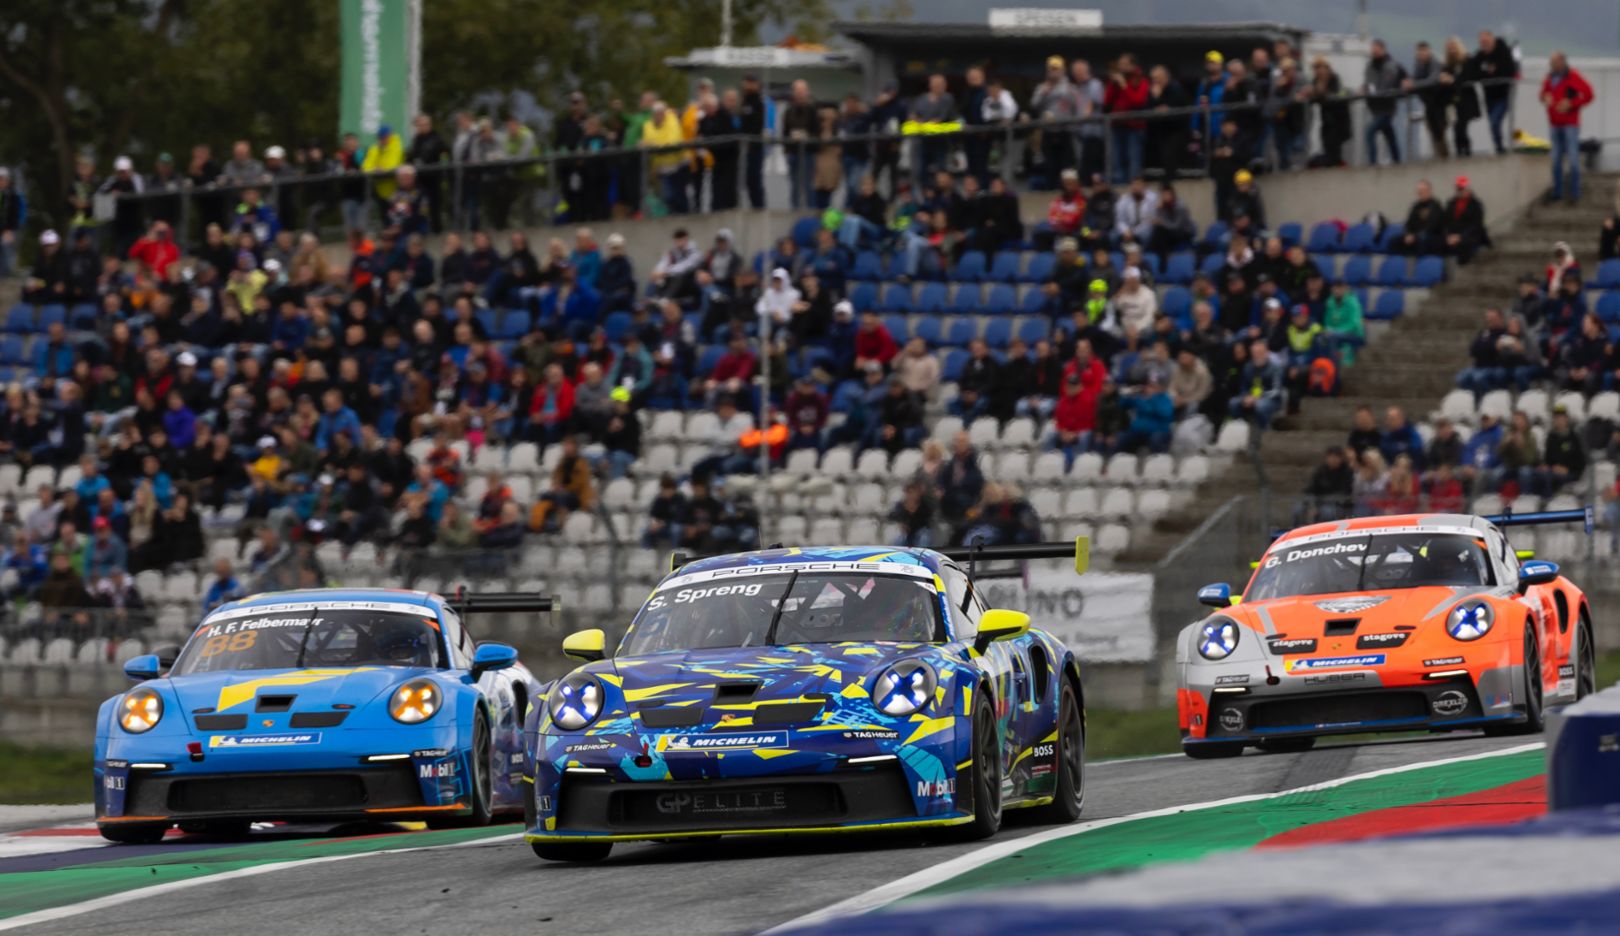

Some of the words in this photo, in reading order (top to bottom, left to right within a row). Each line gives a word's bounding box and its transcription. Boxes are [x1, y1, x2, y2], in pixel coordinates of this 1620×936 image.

[1265, 556, 1282, 569] G.
[1286, 543, 1368, 562] Donchev
[711, 562, 881, 578] PORSCHE
[647, 596, 667, 611] S.
[674, 583, 763, 605] Spreng
[249, 602, 391, 613] PORSCHE
[206, 626, 222, 638] H.
[225, 622, 238, 634] F.
[240, 617, 324, 631] Felbermayr
[1363, 632, 1406, 641] stagove
[201, 629, 258, 658] 88
[1273, 639, 1313, 648] stagove
[1312, 656, 1378, 667] MICHELIN
[1303, 672, 1366, 685] HUBER
[240, 735, 312, 744] MICHELIN
[693, 735, 777, 747] MICHELIN
[1034, 744, 1054, 758] BOSS
